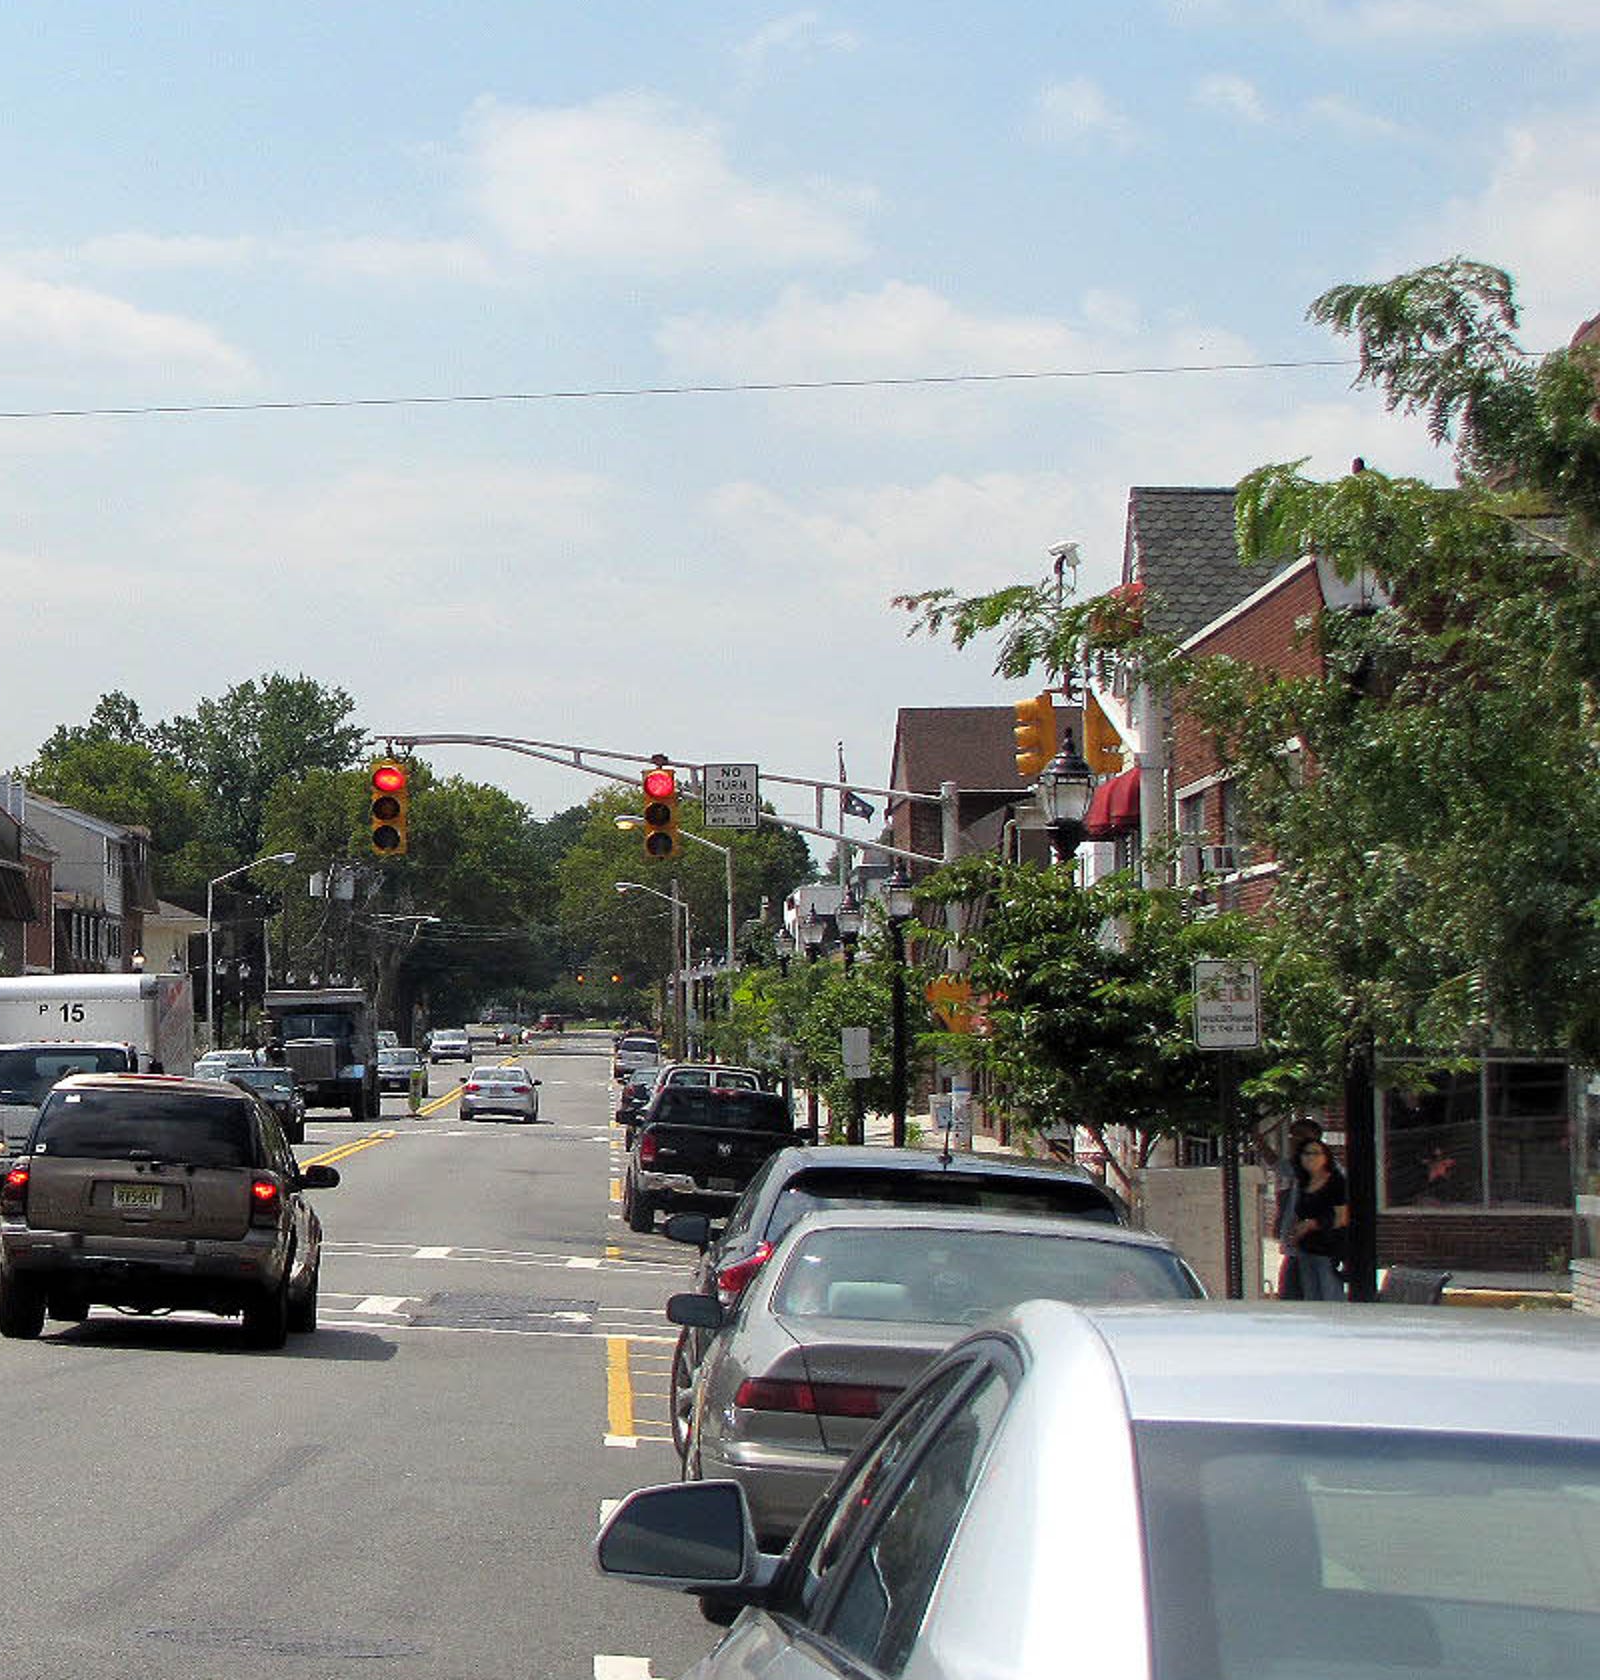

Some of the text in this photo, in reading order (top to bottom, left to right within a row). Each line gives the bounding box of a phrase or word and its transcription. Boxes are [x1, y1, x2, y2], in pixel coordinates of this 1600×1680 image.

[721, 767, 741, 778] NO
[715, 780, 747, 790] TURN
[708, 792, 754, 804] ON RED
[39, 1003, 85, 1023] P 15
